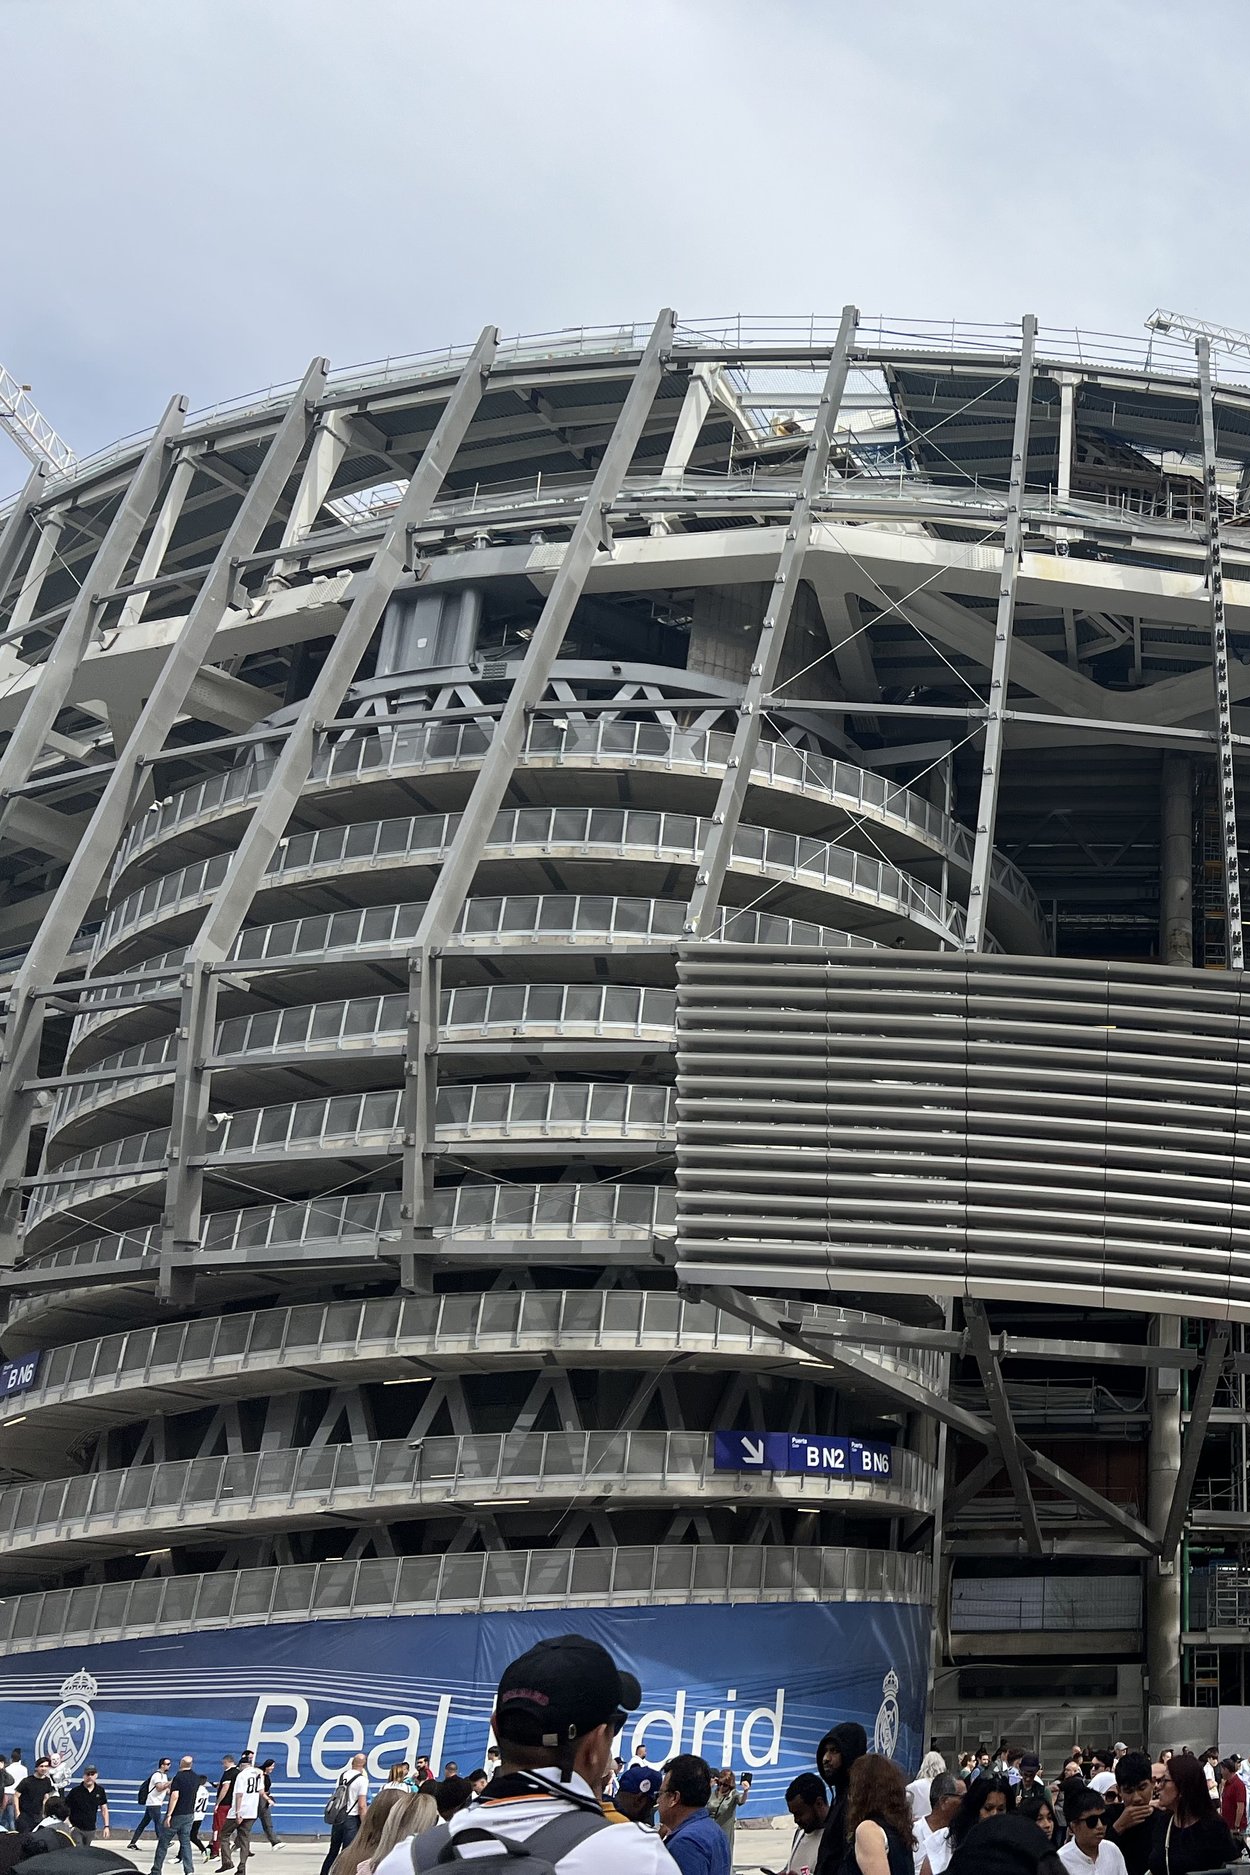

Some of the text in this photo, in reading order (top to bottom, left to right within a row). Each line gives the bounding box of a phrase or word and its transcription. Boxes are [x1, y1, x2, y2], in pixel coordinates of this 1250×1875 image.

[822, 1447, 845, 1469] N2
[874, 1452, 889, 1473] N6
[247, 1693, 452, 1779] Real
